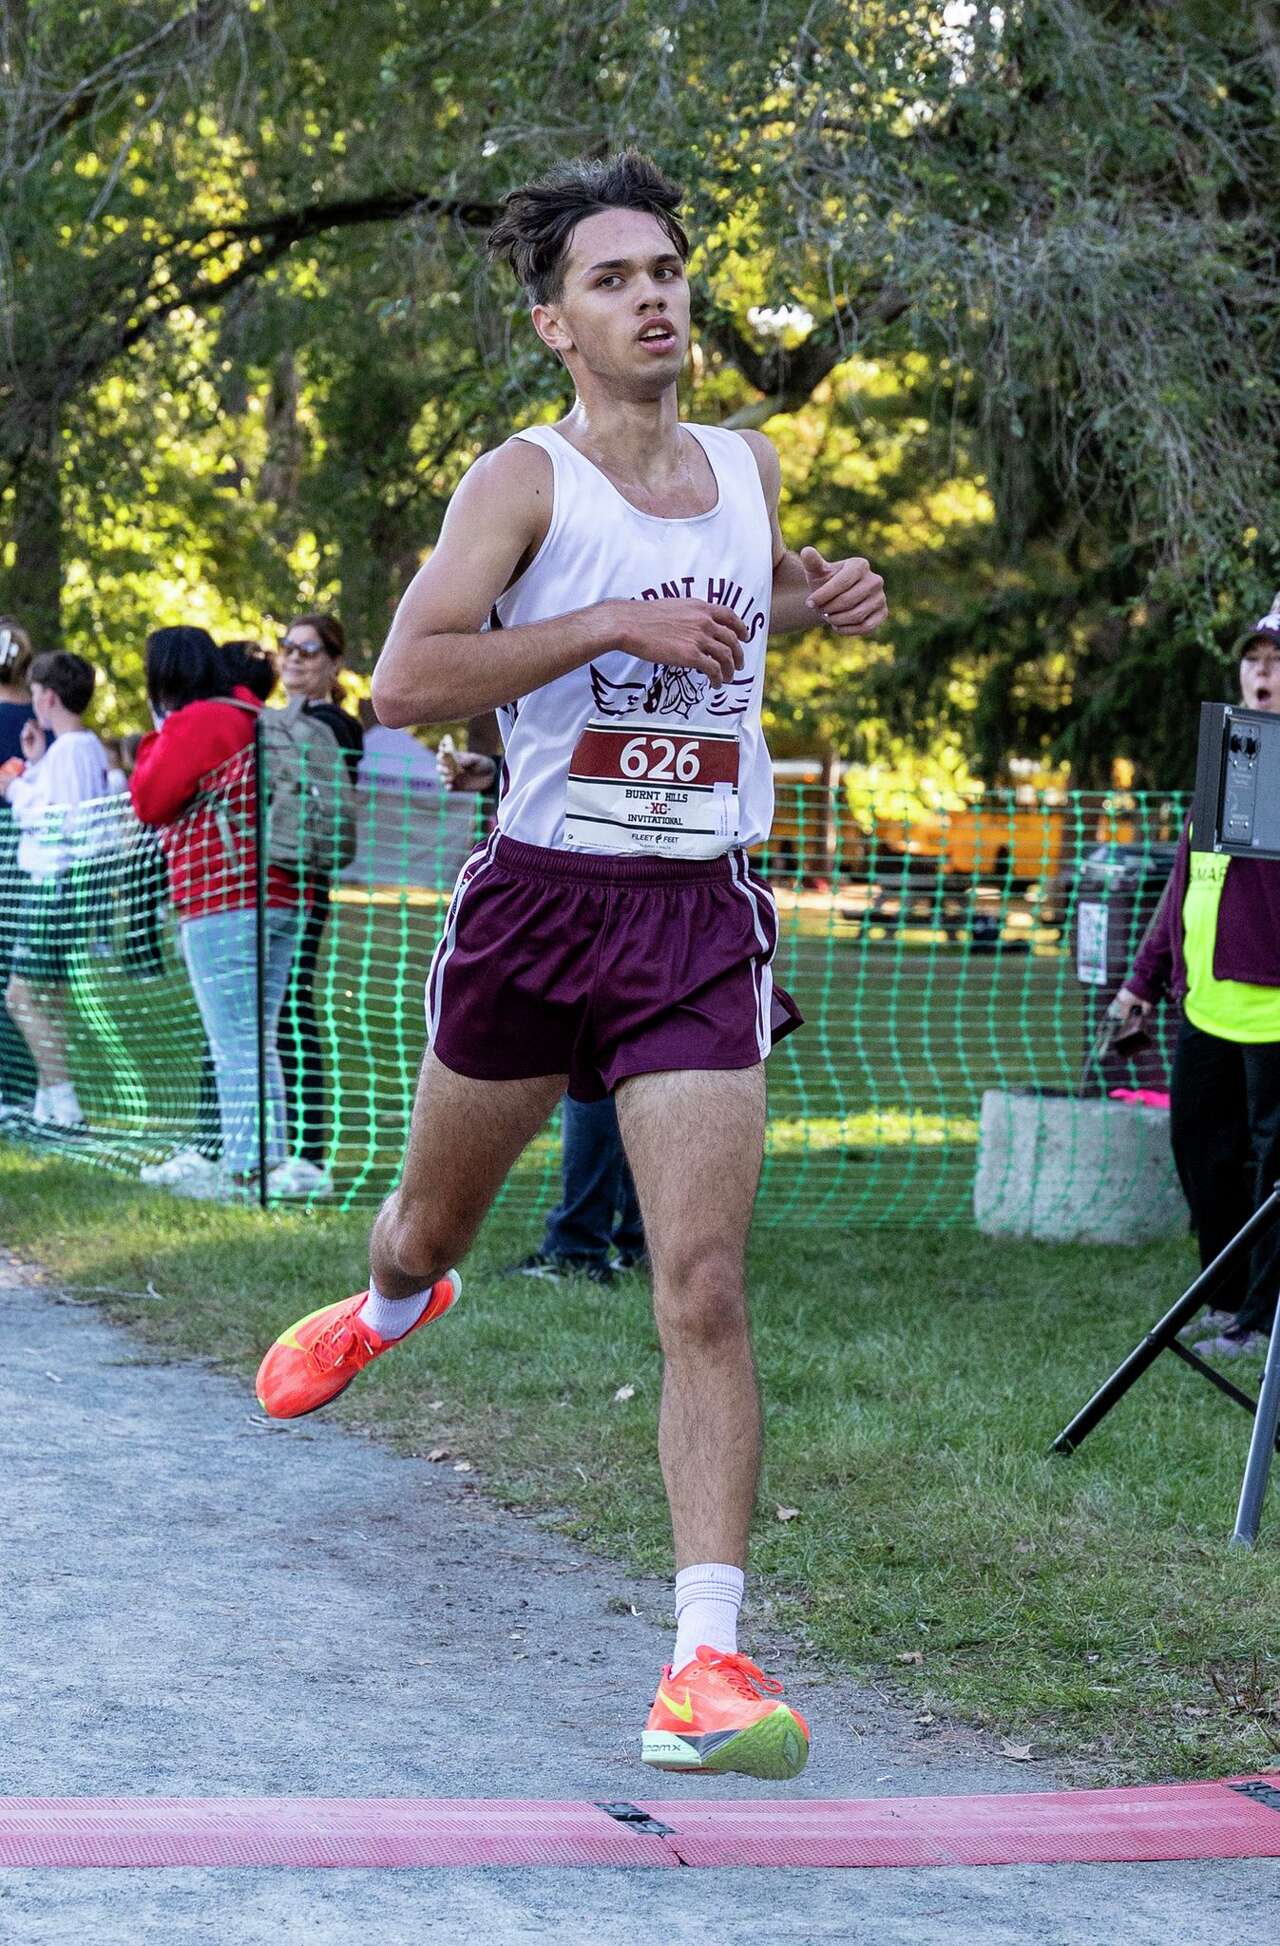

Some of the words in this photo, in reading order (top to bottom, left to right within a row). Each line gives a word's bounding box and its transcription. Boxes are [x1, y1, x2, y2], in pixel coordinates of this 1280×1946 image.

[620, 736, 700, 782] 626
[625, 789, 661, 801] BURNT
[665, 792, 689, 803] HILLS
[627, 814, 684, 826] INVITATIONAL
[631, 833, 655, 842] FLEET
[663, 836, 680, 844] FEET
